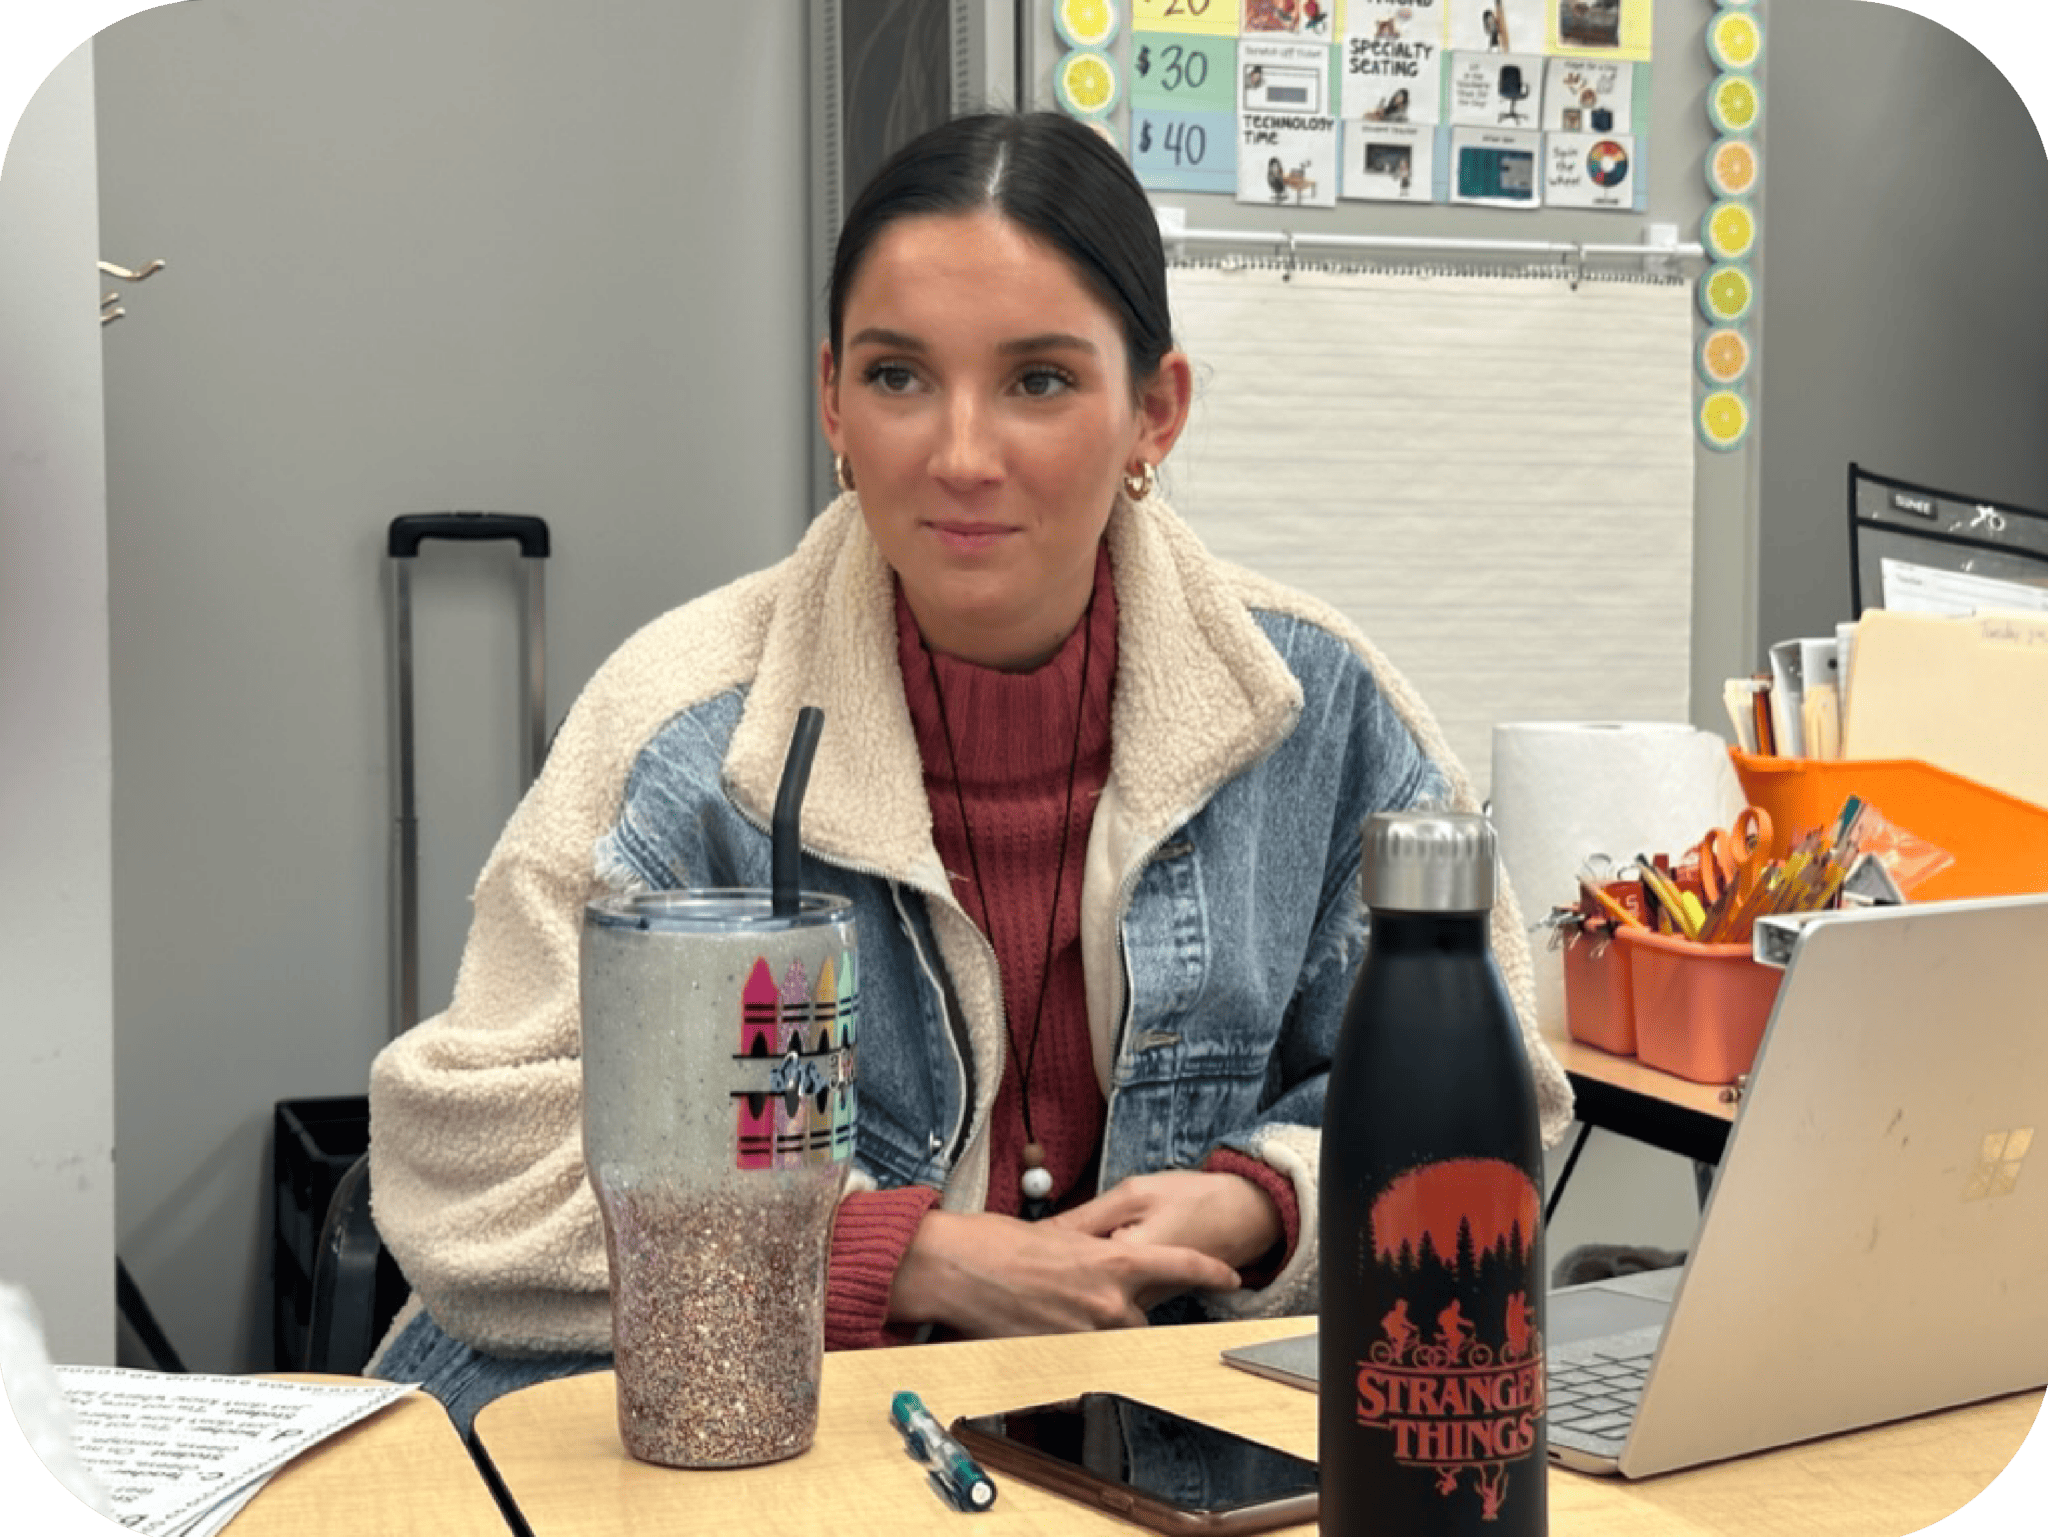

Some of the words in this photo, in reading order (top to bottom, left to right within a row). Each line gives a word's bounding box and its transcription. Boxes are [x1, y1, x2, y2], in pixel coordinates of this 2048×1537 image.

[1349, 37, 1435, 61] SPECIALTY
[1135, 44, 1209, 91] $30
[1349, 57, 1419, 78] SEATING
[1243, 114, 1335, 132] TECHNOLOGY
[1138, 118, 1207, 167] $40
[1243, 129, 1279, 146] TIME
[1389, 1412, 1534, 1460] THINGS
